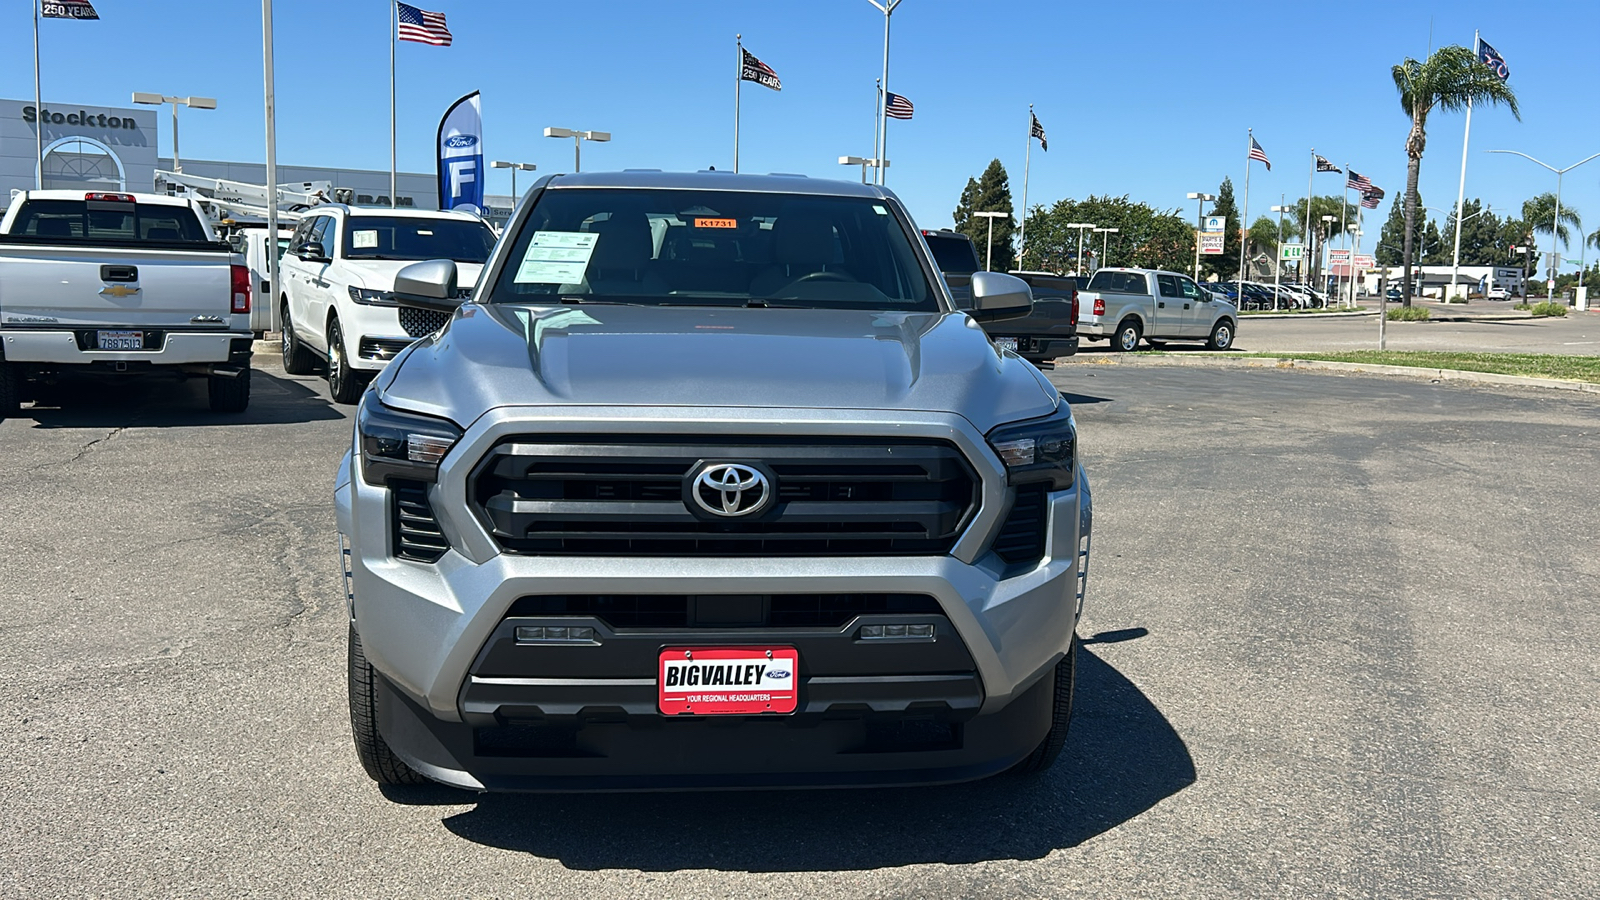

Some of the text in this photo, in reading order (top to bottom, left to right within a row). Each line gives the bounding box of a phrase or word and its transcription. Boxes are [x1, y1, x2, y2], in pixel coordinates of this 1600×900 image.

[43, 4, 97, 17] 250 YEARS
[743, 68, 782, 88] 250 YEARS
[22, 106, 136, 130] Stockton
[448, 160, 476, 198] F
[358, 194, 413, 206] RAM
[102, 338, 140, 349] 78875U3
[729, 694, 770, 702] HEADQUARTERS
